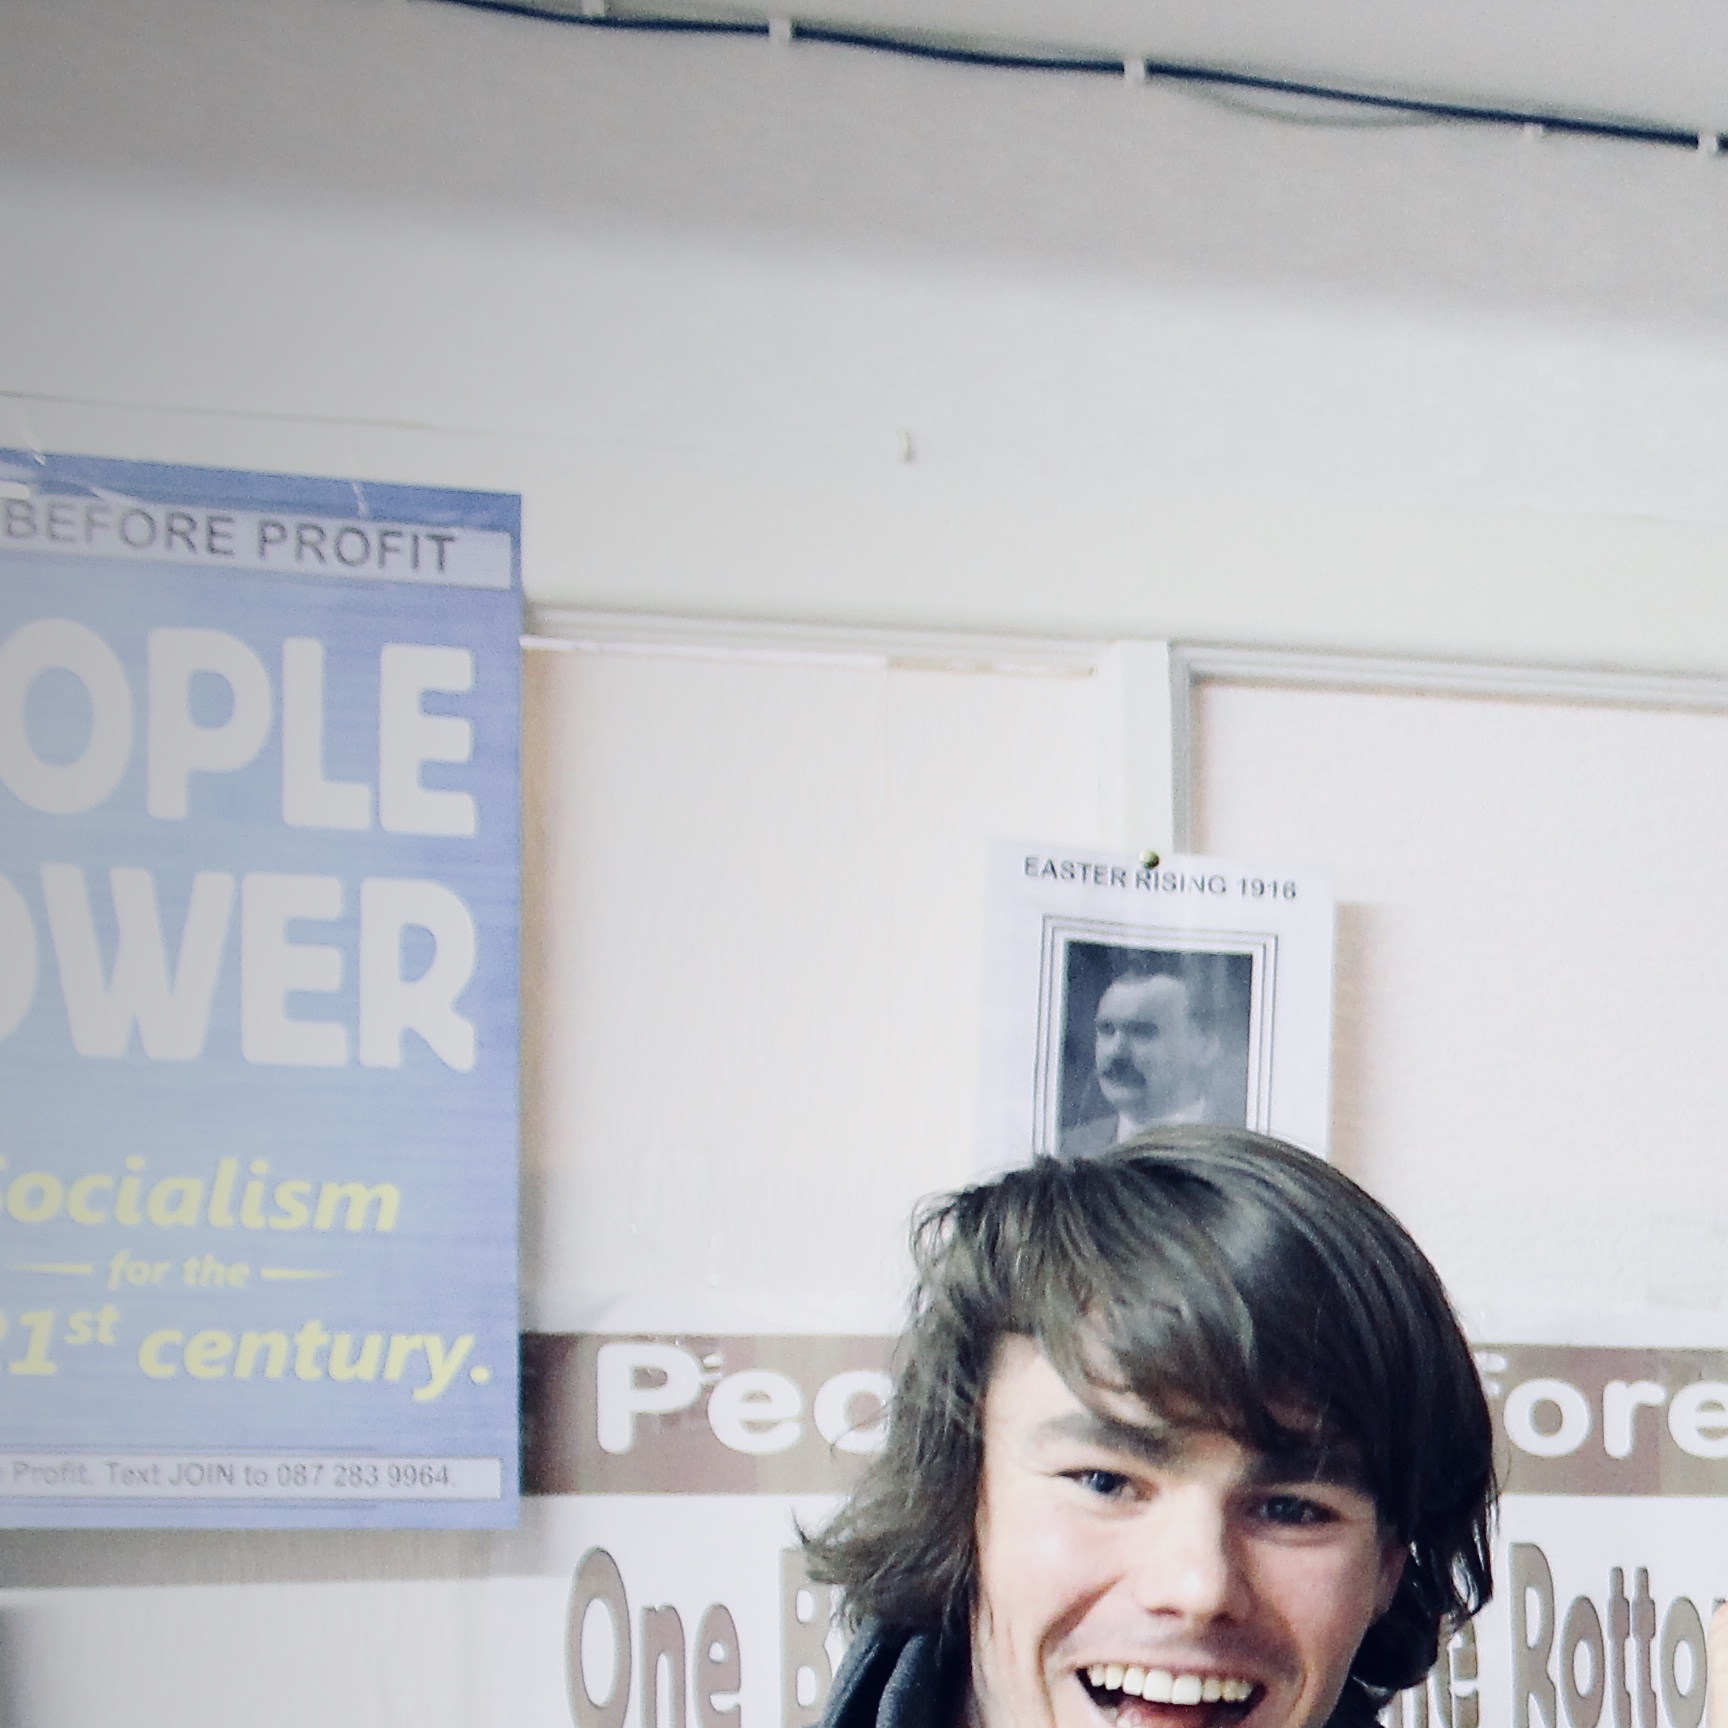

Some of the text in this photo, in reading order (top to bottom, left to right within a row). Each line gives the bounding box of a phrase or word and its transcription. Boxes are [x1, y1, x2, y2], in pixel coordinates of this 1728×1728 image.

[4, 500, 457, 576] BEFORE PROFIT
[1023, 855, 1298, 901] EASTER RISING 1916
[0, 1155, 402, 1234] ocialism
[106, 1249, 250, 1290] for the
[0, 1304, 493, 1402] 1st century.
[11, 1459, 93, 1488] Profit.
[106, 1460, 161, 1487] Text
[168, 1462, 236, 1488] JOIN
[243, 1464, 269, 1488] to
